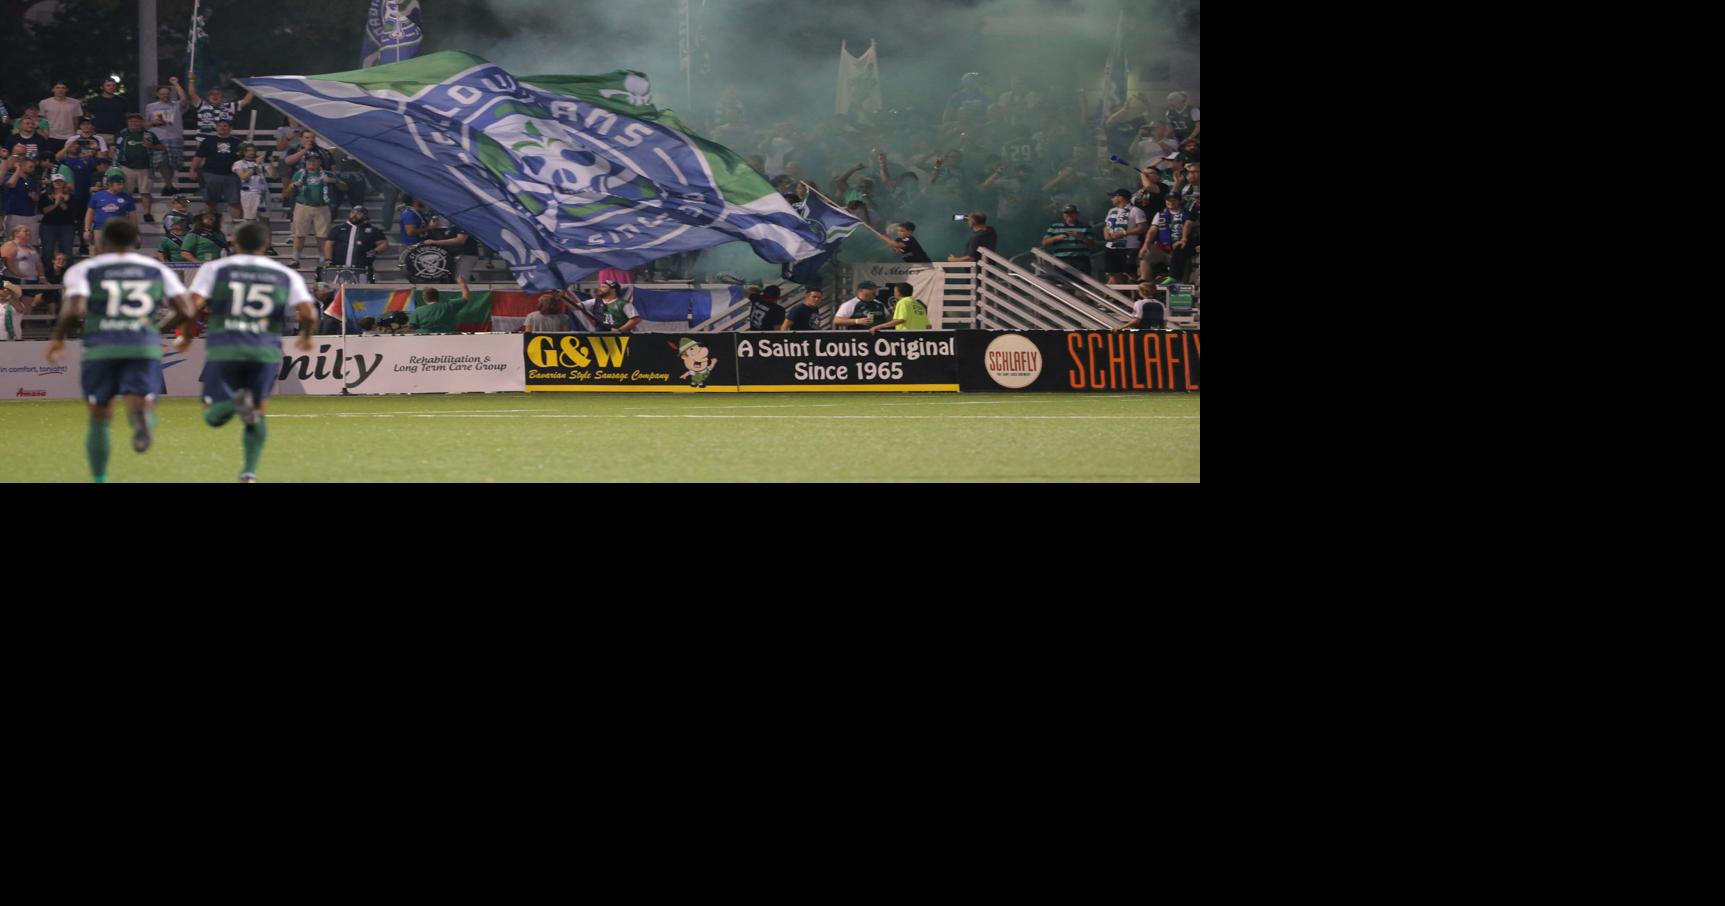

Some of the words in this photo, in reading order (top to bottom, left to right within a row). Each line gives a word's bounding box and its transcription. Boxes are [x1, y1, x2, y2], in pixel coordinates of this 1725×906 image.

[101, 280, 154, 317] 13
[228, 281, 274, 318] 15
[409, 355, 480, 364] Rehabilitation
[484, 355, 491, 363] &
[527, 335, 630, 368] G&W
[737, 340, 753, 357] A
[758, 339, 809, 357] Saint
[815, 338, 869, 357] Louis
[874, 338, 955, 360] Original
[278, 344, 383, 389] nity
[394, 363, 418, 373] Long
[421, 363, 446, 372] Term
[449, 362, 472, 371] Care
[475, 361, 507, 371] Group
[794, 362, 848, 380] Since
[856, 361, 903, 380] 1965
[989, 351, 1037, 372] SCHLAFLY
[528, 370, 566, 379] Bavarian
[569, 370, 591, 380] Style
[594, 370, 628, 381] Sausage
[631, 369, 670, 381] Company
